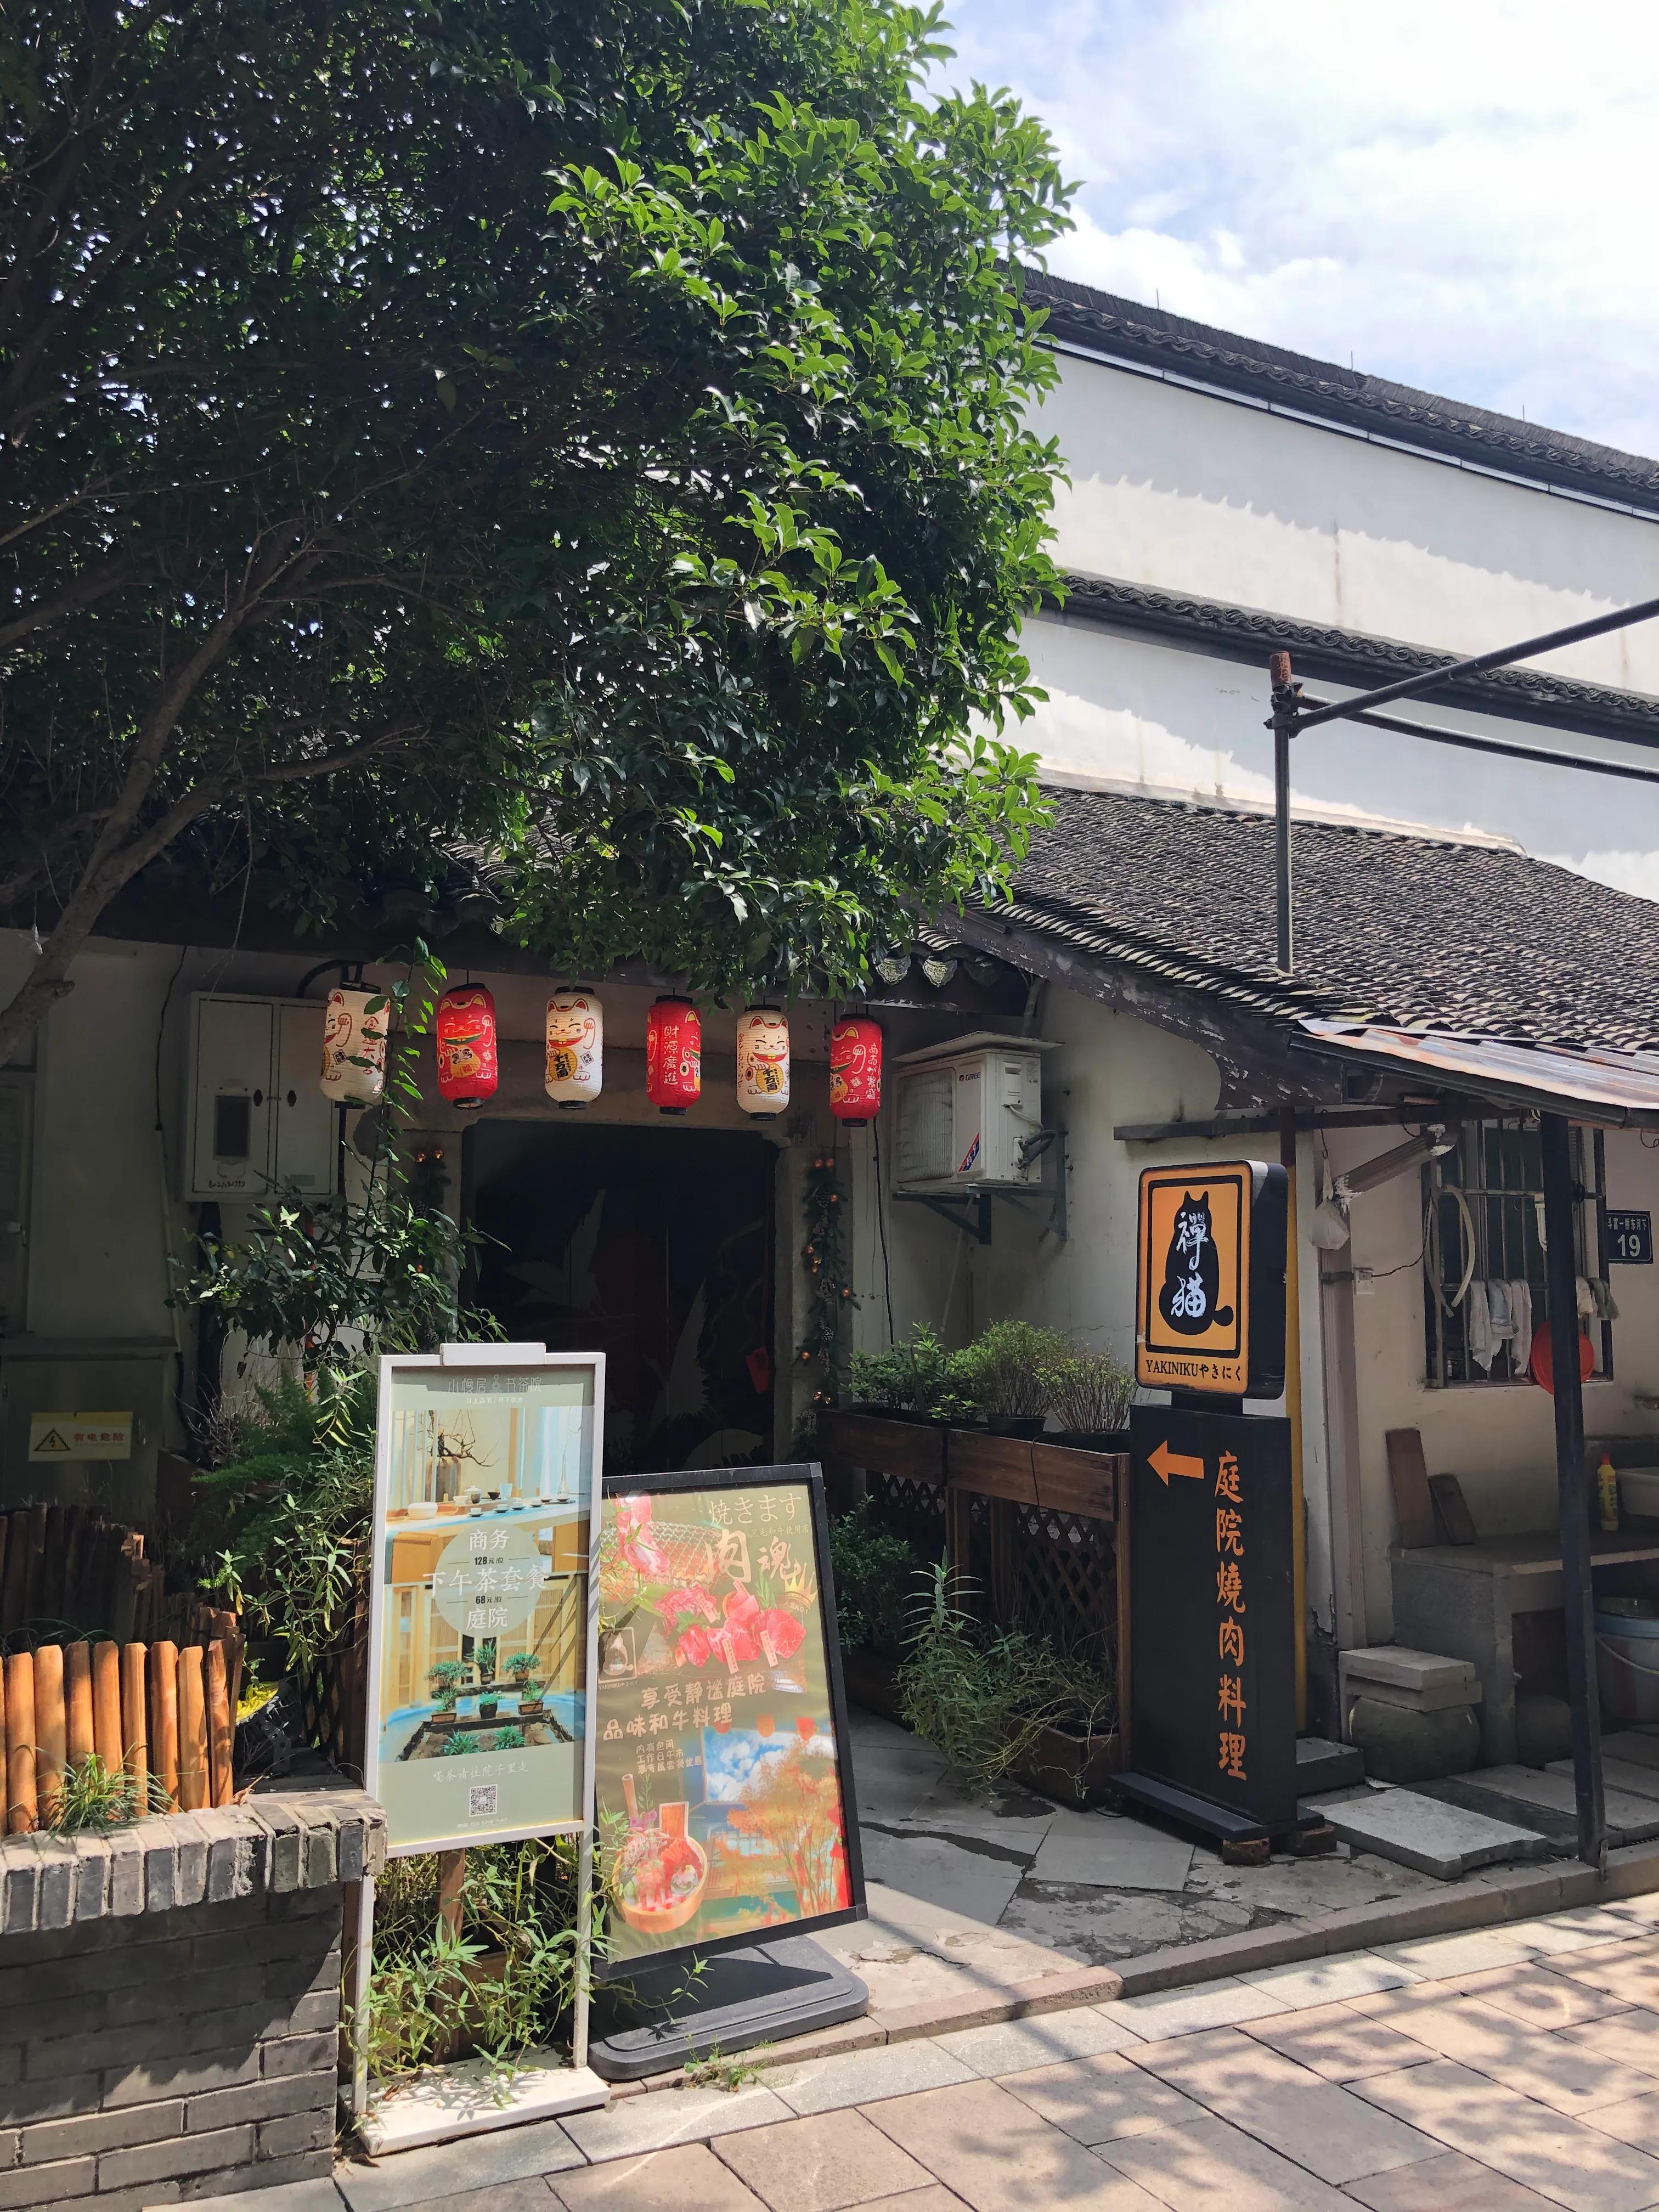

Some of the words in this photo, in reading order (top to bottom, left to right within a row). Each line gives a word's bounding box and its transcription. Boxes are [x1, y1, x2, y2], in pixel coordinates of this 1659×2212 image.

[965, 1071, 981, 1081] GREE
[1617, 1234, 1640, 1257] 19
[708, 1492, 802, 1526] 焼きます
[470, 1528, 510, 1551] 商务
[422, 1564, 550, 1598] 下午茶套餐
[465, 1606, 508, 1630] 庭院
[641, 1672, 767, 1711] 享受静谧庭院
[603, 1702, 733, 1741] 品味和牛料理
[636, 1739, 674, 1754] 内有包间
[636, 1748, 684, 1764] 工作日午市
